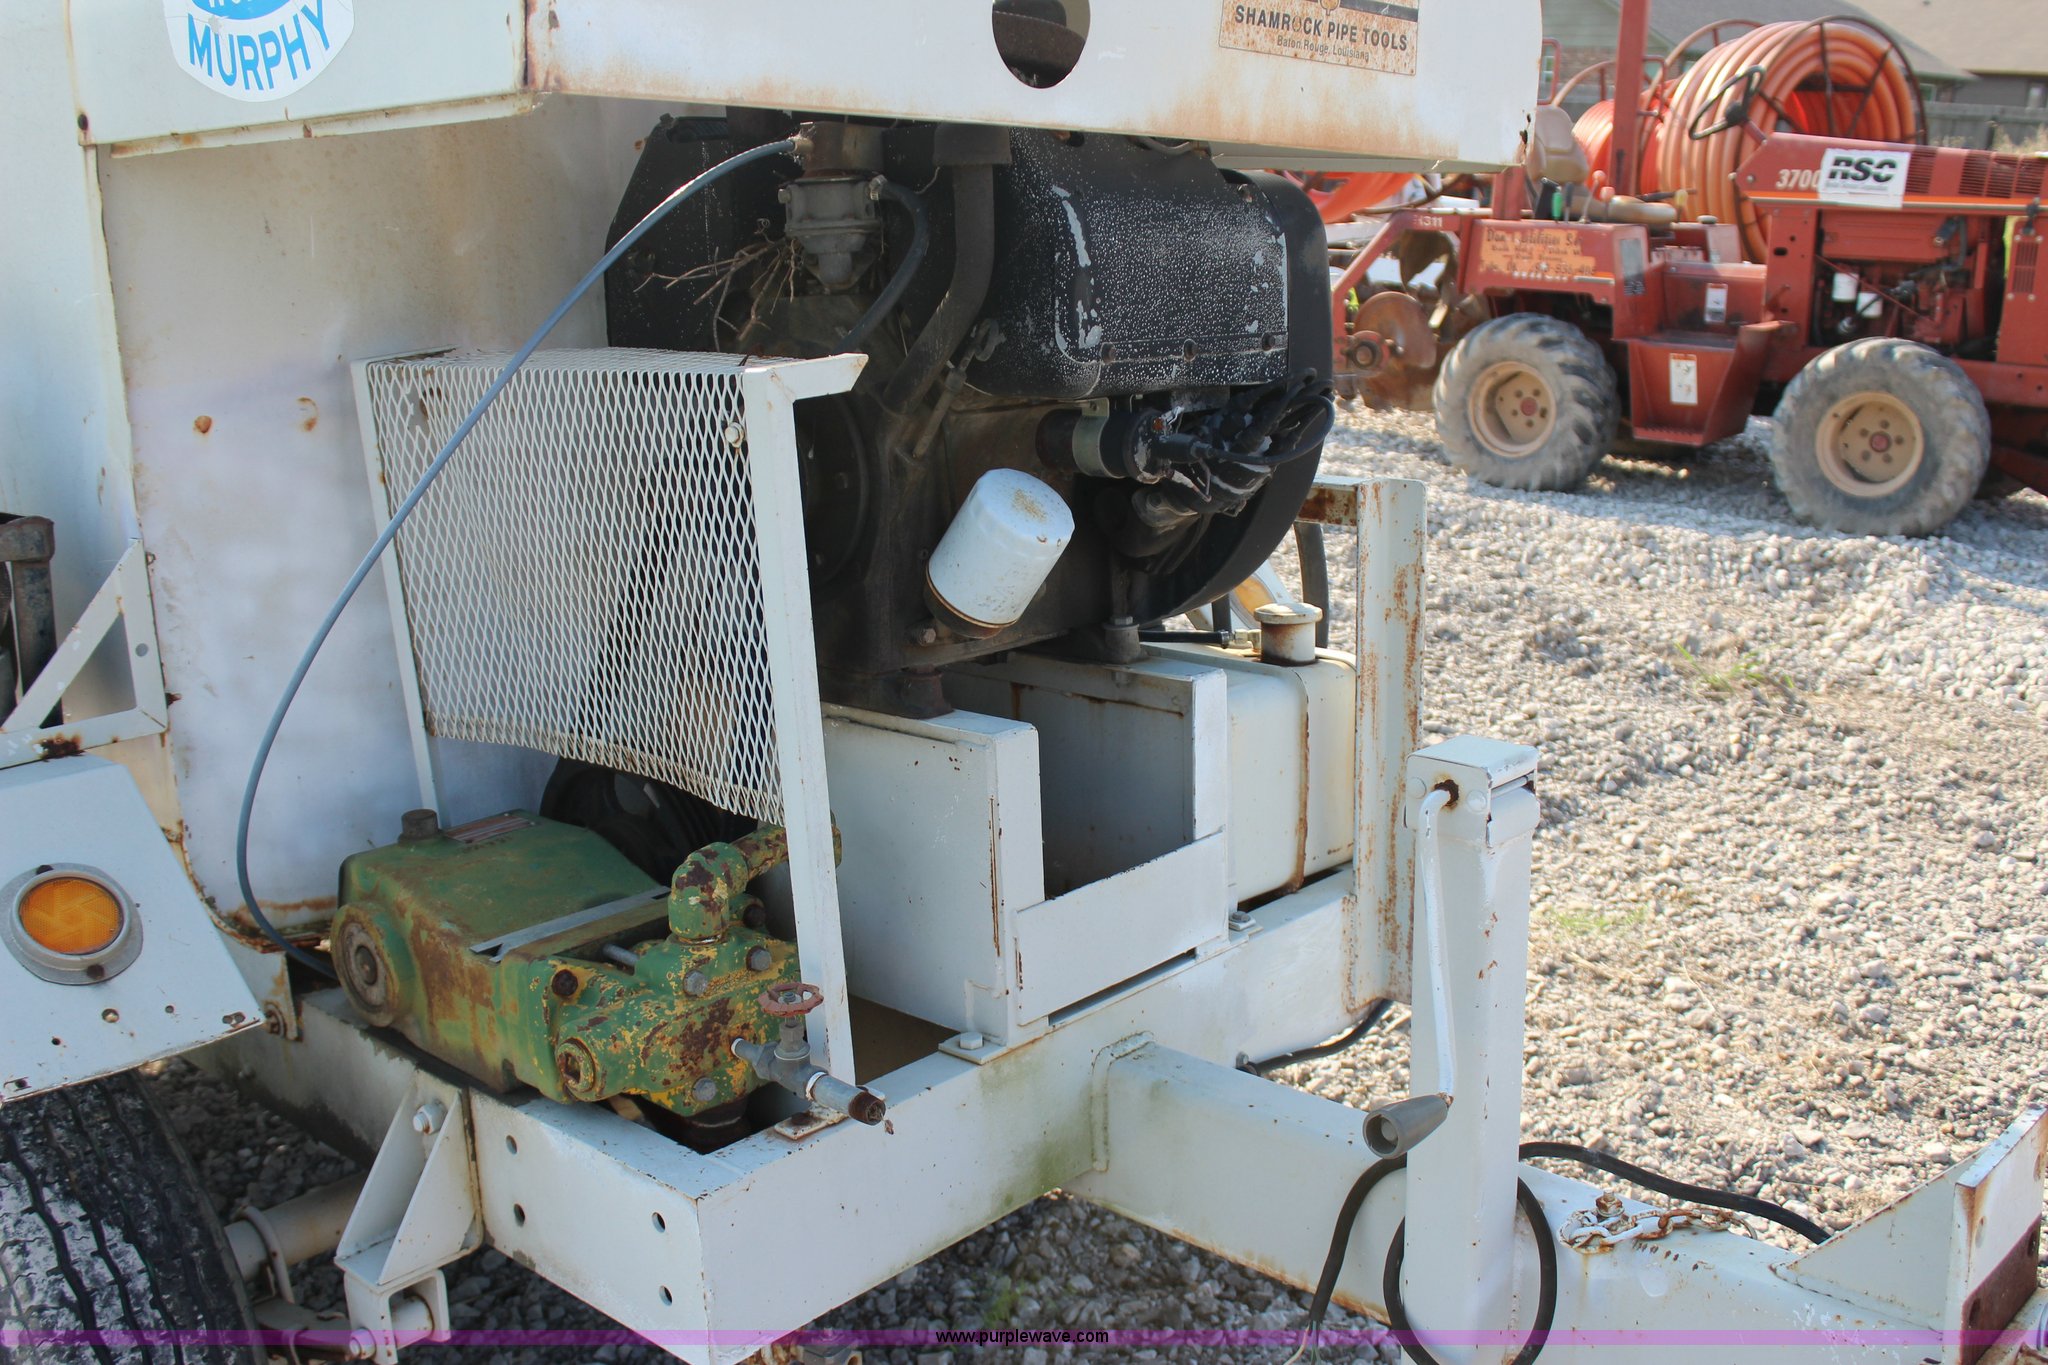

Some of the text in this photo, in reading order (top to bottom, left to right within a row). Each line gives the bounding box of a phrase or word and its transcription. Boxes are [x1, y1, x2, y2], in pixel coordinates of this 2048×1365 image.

[1235, 5, 1408, 51] SHAMROCK PIPE TOOLS
[188, 0, 330, 90] MURPHY
[1276, 35, 1301, 49] Baton
[1332, 45, 1370, 62] Louisiana
[1775, 169, 1819, 190] 3700
[1828, 156, 1897, 183] RSC
